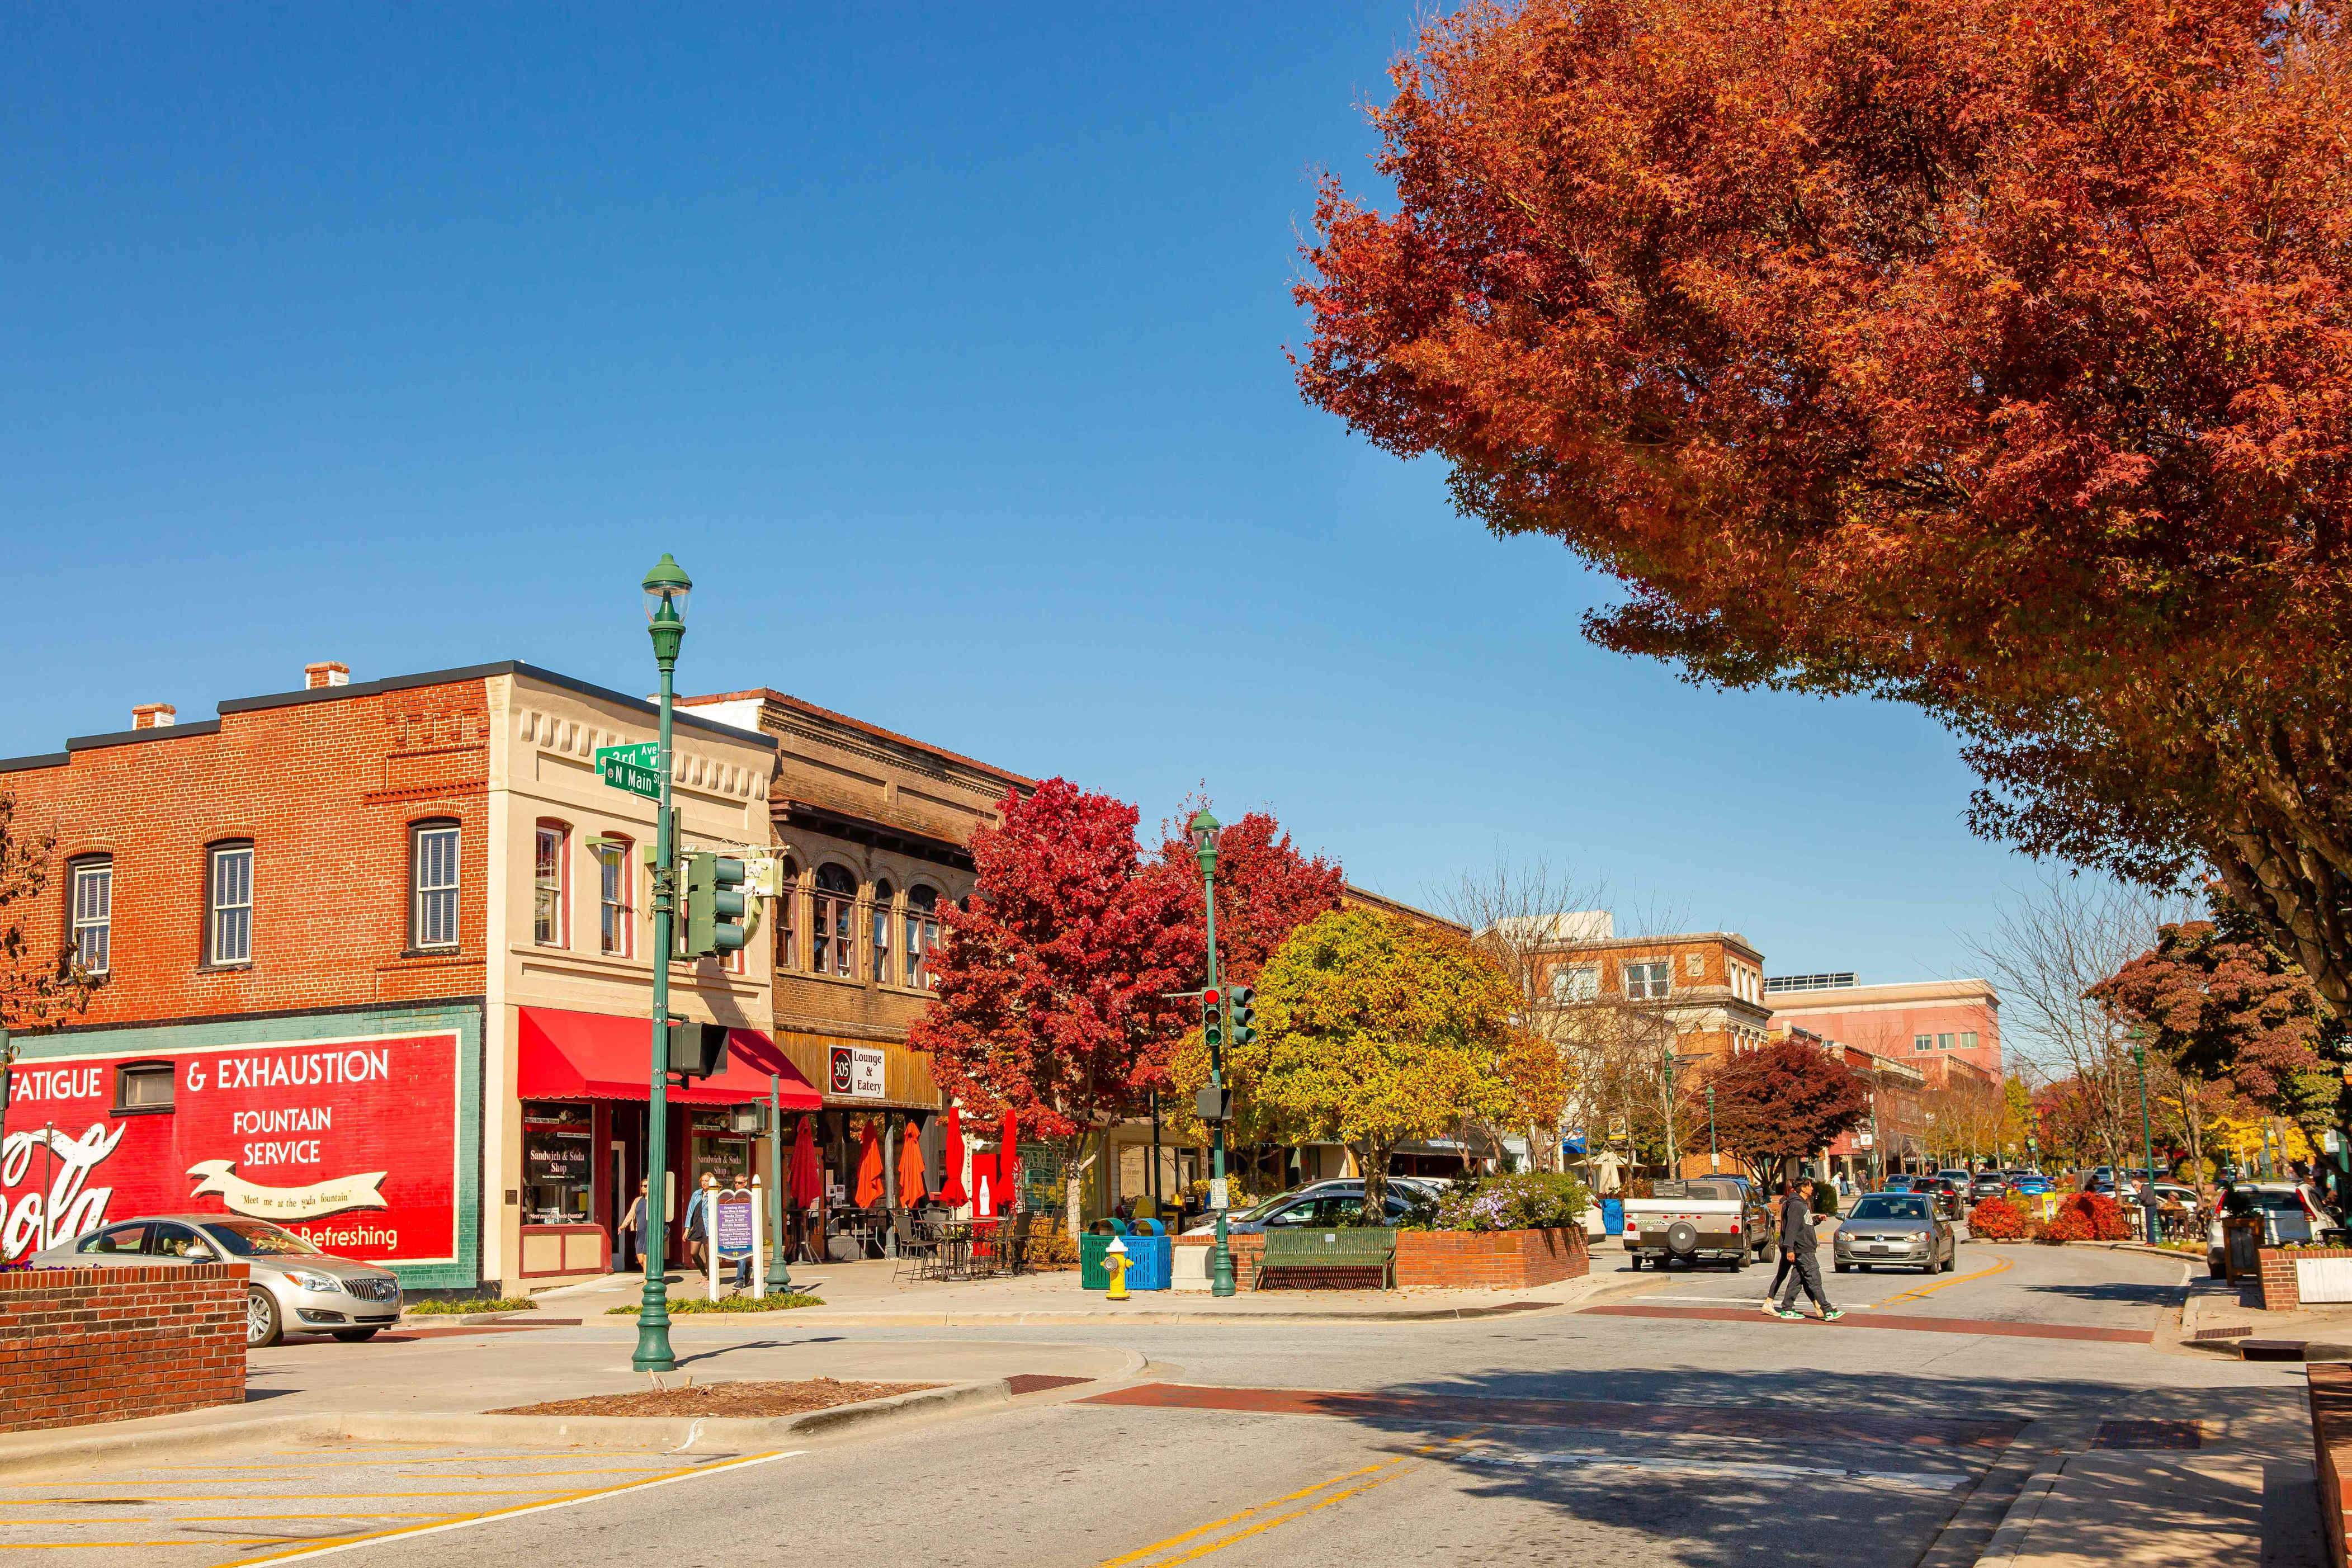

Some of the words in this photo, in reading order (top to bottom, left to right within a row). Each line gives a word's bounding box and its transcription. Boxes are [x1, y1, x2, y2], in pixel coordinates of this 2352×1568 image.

[641, 744, 657, 756] Ave
[615, 766, 622, 784] N
[628, 768, 651, 792] Main
[653, 773, 660, 785] St
[854, 1051, 882, 1066] Lounge
[187, 1061, 206, 1092] &
[218, 1049, 389, 1088] EXHAUSTION
[835, 1061, 849, 1077] 305
[866, 1066, 872, 1077] &
[857, 1080, 881, 1094] Eatery
[233, 1107, 332, 1134] FOUNTAIN
[244, 1140, 320, 1166] SERVICE
[530, 1150, 560, 1160] Sandwich
[562, 1151, 568, 1161] &
[569, 1151, 584, 1161] Soda
[697, 1154, 722, 1164] Sandwich
[551, 1162, 567, 1175] Shop
[714, 1167, 727, 1177] Shop
[286, 1198, 297, 1207] the
[301, 1195, 315, 1205] soda
[301, 1225, 398, 1251] Refreshing
